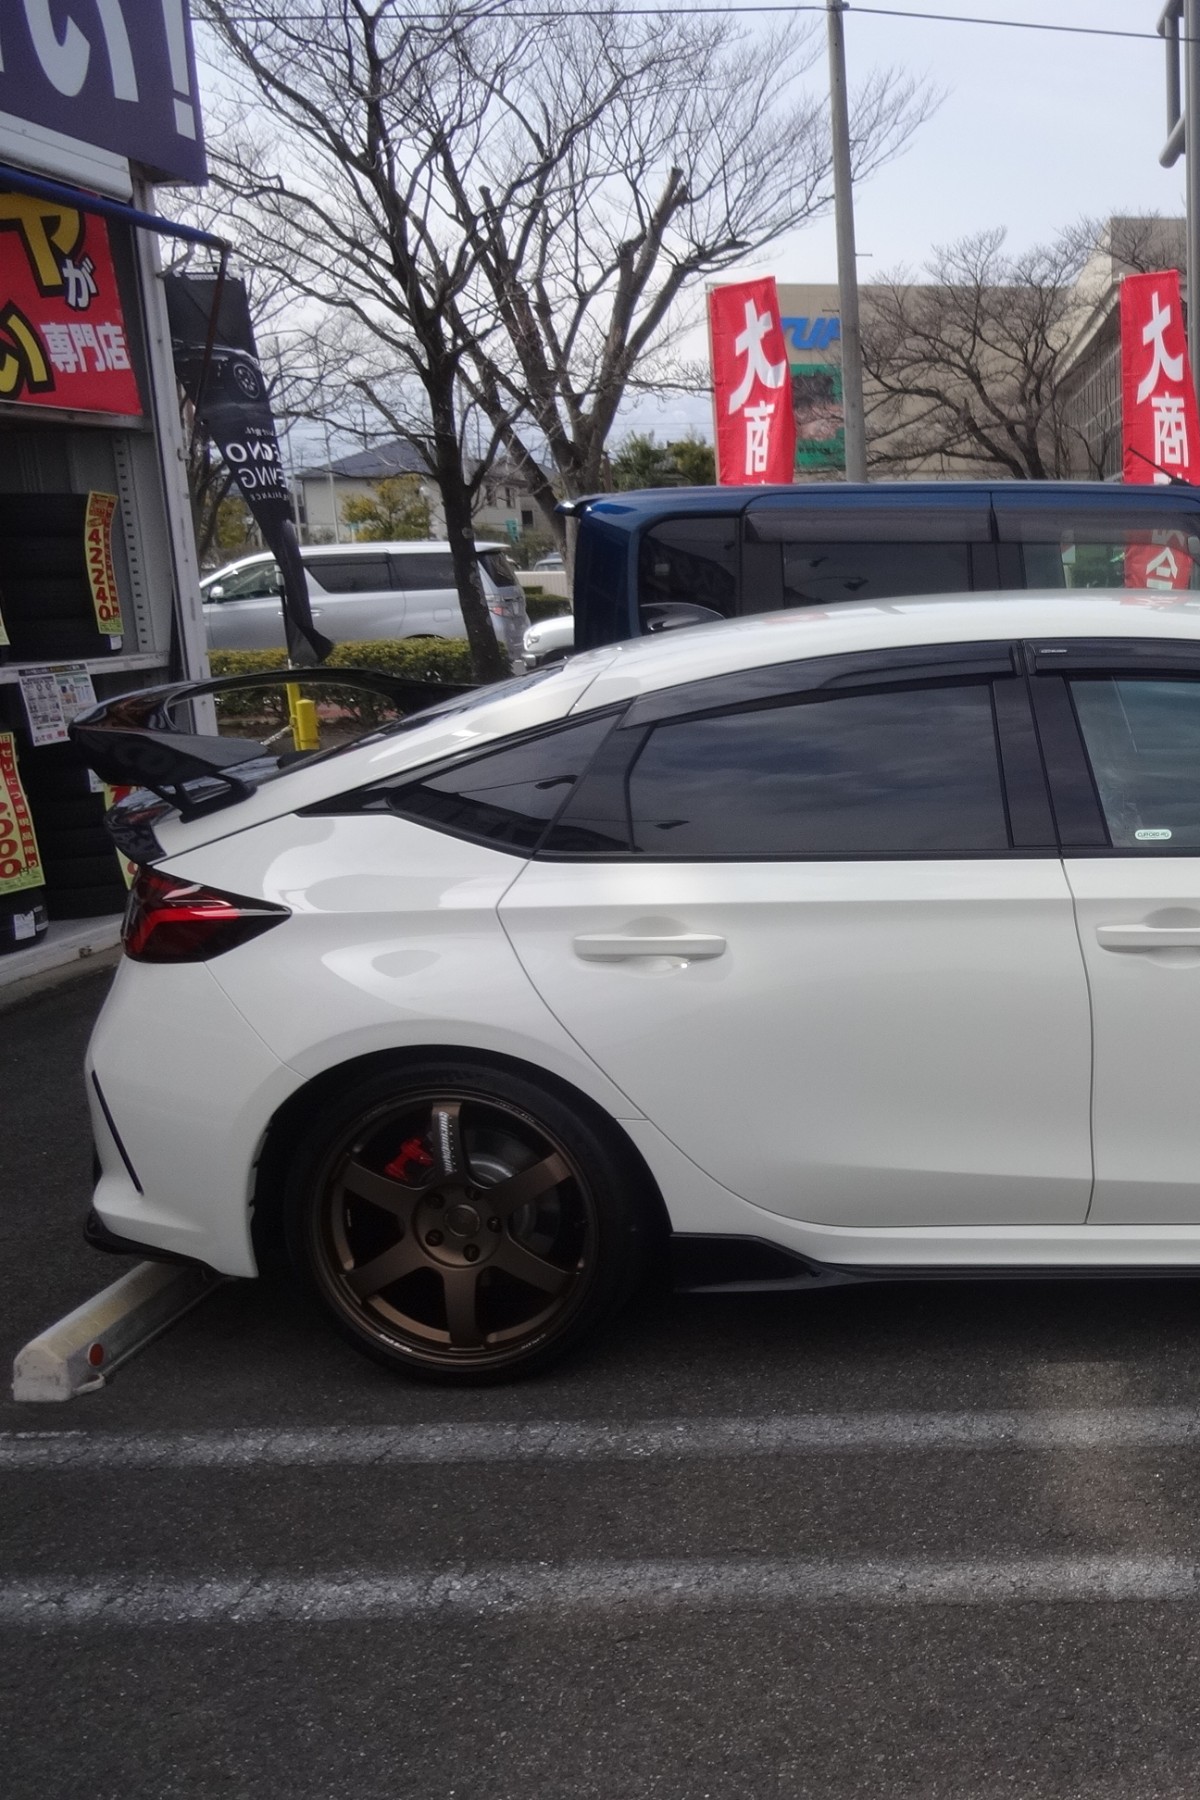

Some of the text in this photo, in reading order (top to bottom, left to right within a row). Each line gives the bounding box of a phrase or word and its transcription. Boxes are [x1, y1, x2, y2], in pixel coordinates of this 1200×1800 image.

[0, 0, 197, 140] い!
[40, 322, 131, 374] 専門店
[729, 298, 787, 484] 大商
